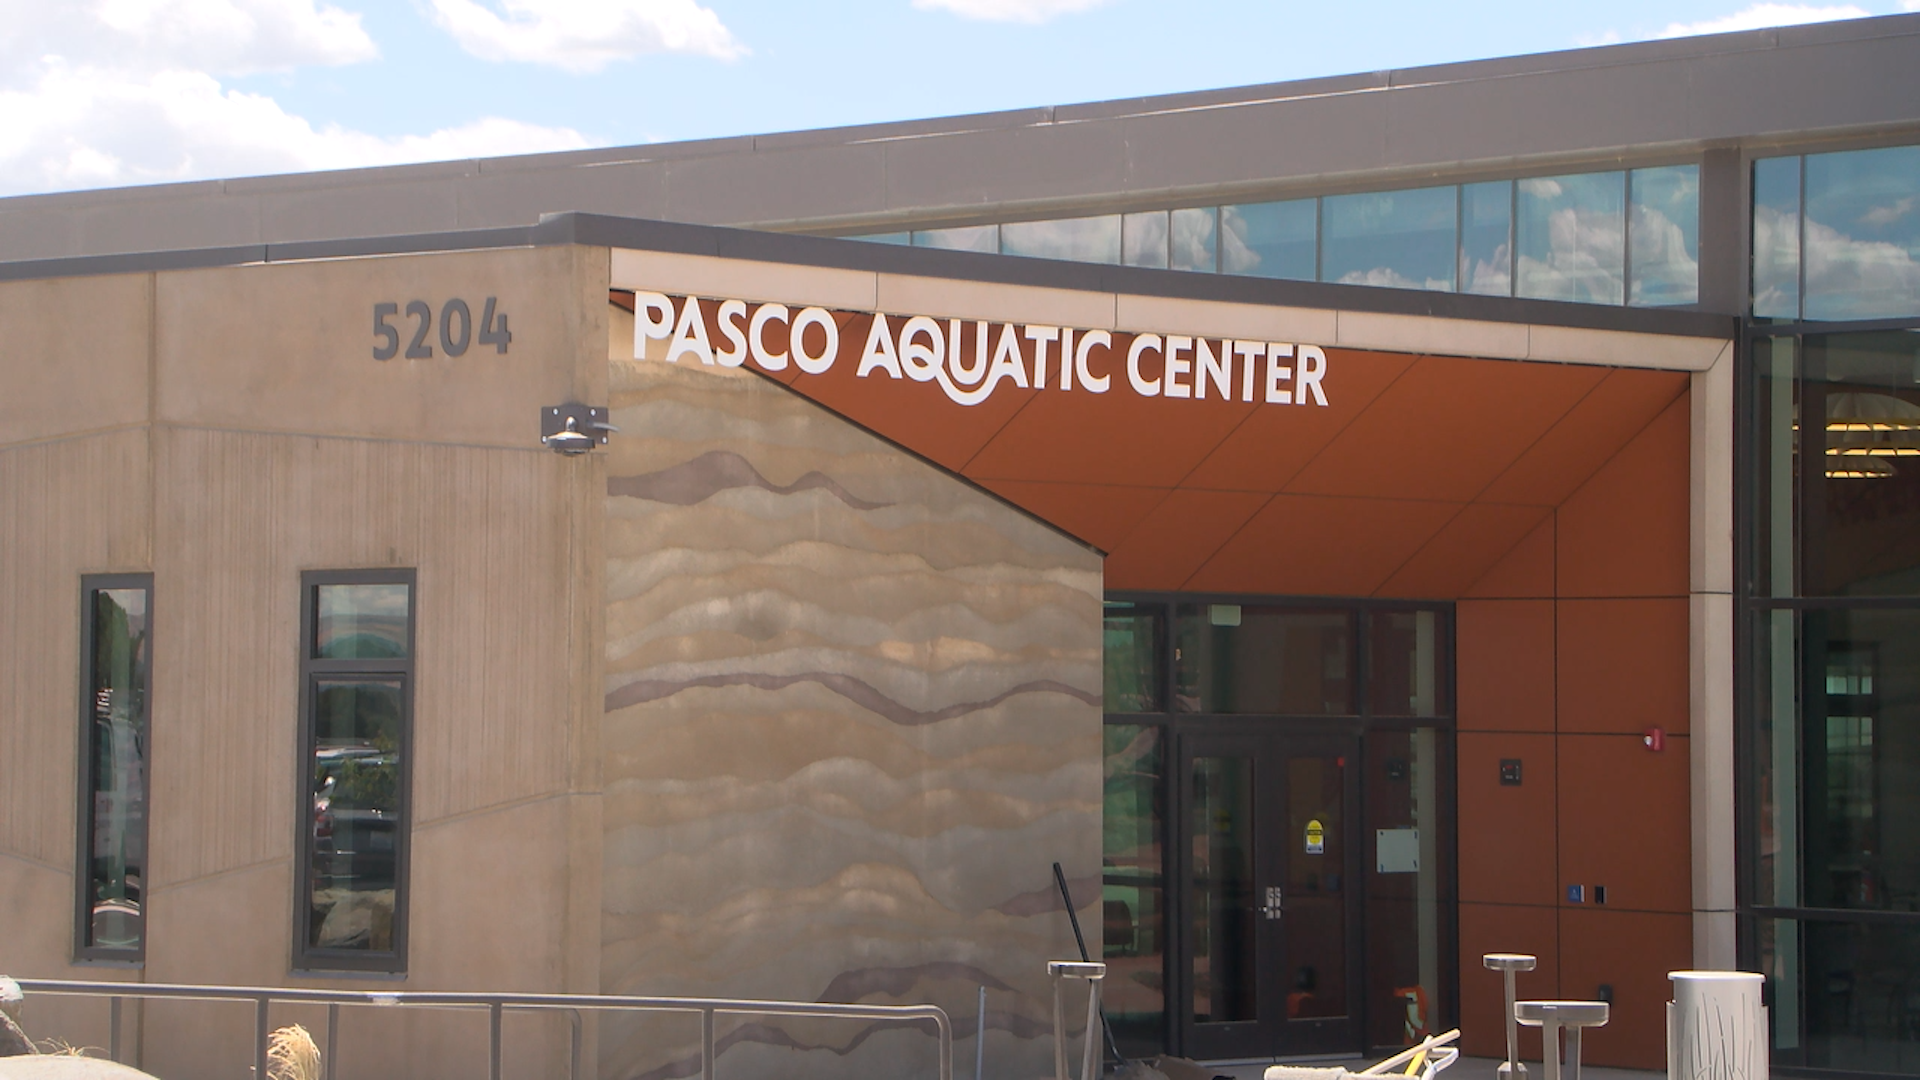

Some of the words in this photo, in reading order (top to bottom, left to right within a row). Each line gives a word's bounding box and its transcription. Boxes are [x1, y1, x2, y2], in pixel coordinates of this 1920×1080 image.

[372, 297, 512, 361] 5204
[634, 291, 840, 374] PASCO
[857, 312, 1112, 405] AQUATIC
[1127, 333, 1329, 406] CENTER
